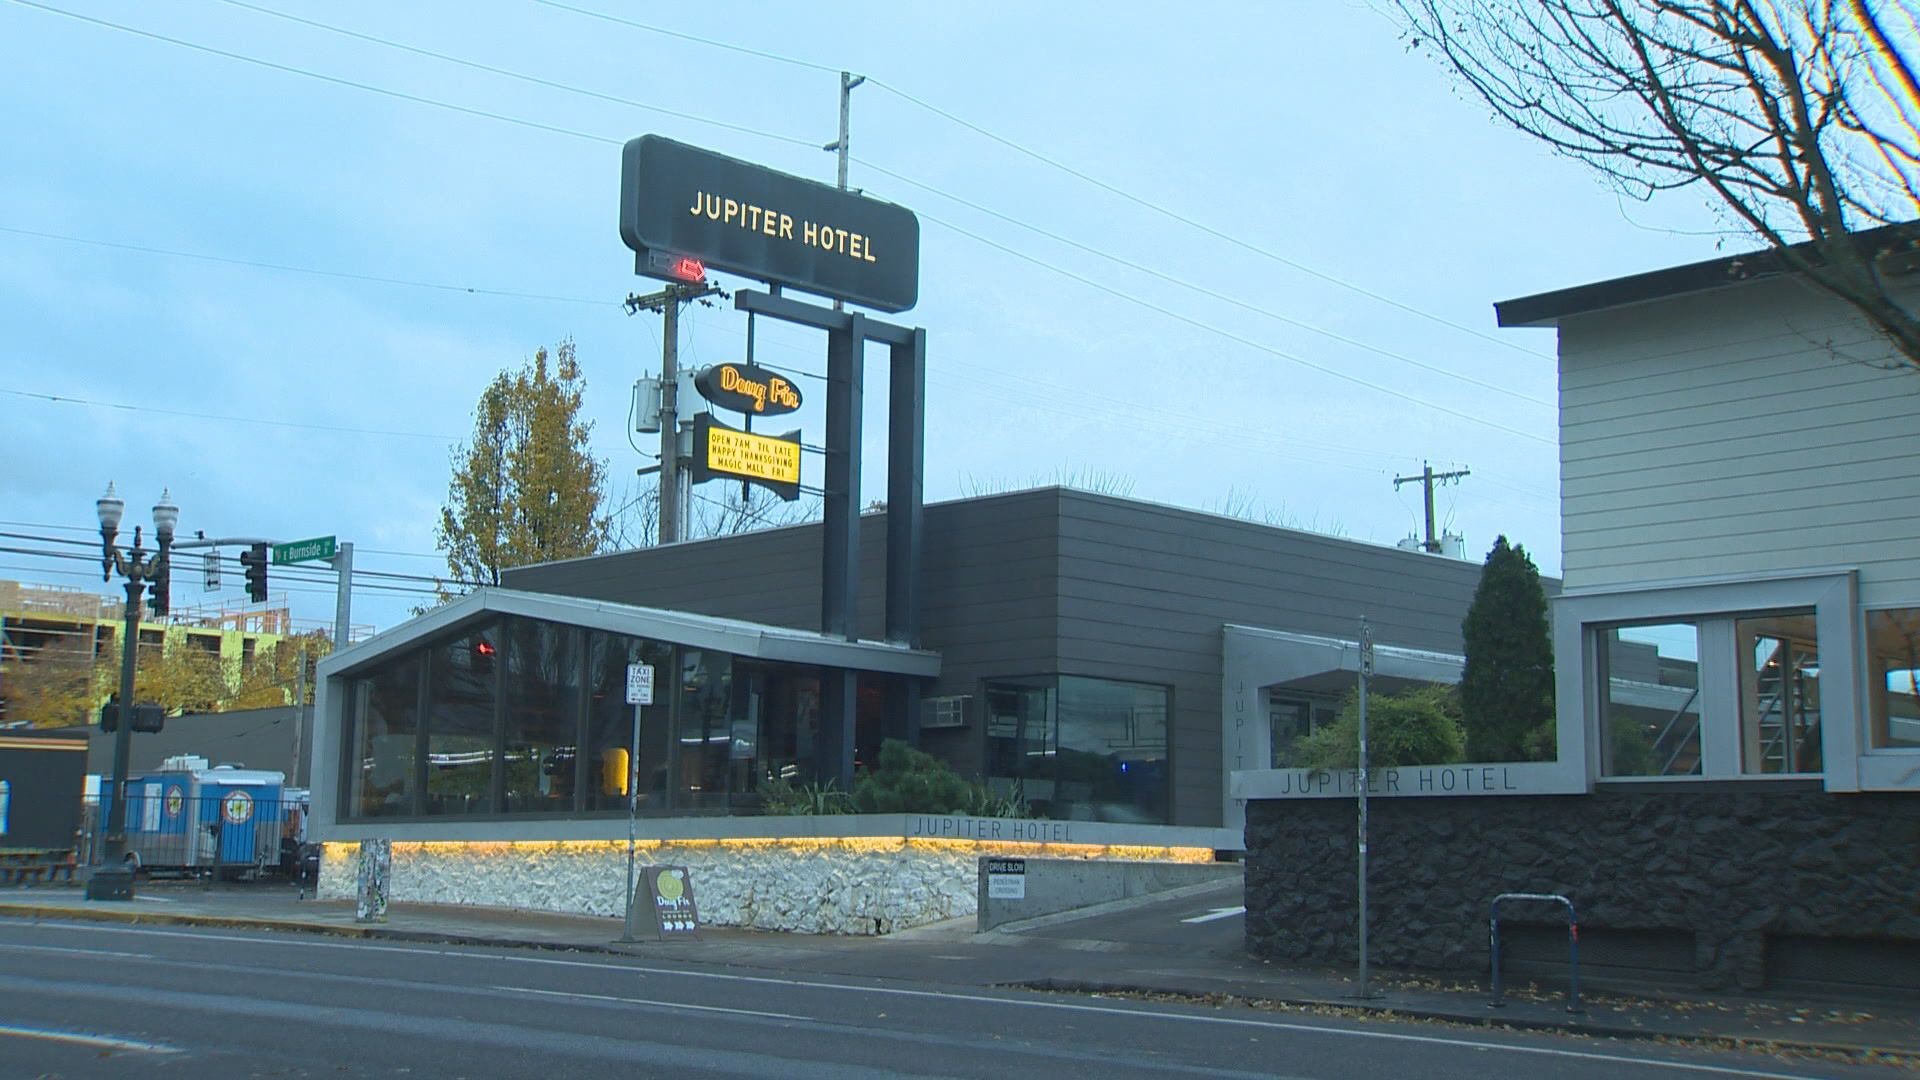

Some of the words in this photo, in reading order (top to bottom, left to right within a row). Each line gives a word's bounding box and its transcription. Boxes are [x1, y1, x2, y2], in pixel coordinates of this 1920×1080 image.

[690, 190, 793, 240] JUPITER
[803, 220, 877, 262] HOTEL
[721, 366, 767, 411] Doug
[769, 378, 799, 409] Fir
[711, 433, 731, 446] OPEN
[735, 437, 750, 449] 7AM
[774, 445, 792, 457] LATE
[712, 444, 736, 457] HAPPY
[740, 450, 793, 468] THANKSGIVING
[718, 457, 742, 470] MAGIC
[772, 467, 785, 477] FRI
[289, 543, 321, 560] Burnside
[630, 676, 649, 684] ZONE
[632, 667, 650, 675] TAXI
[1235, 679, 1245, 808] JUPITR
[1281, 769, 1400, 794] JUPITER
[1419, 767, 1517, 792] HOTEL
[914, 817, 1001, 838] JUPITER
[1013, 822, 1073, 842] HOTEL
[989, 862, 1007, 872] DRIVE
[1007, 863, 1024, 873] SLOW
